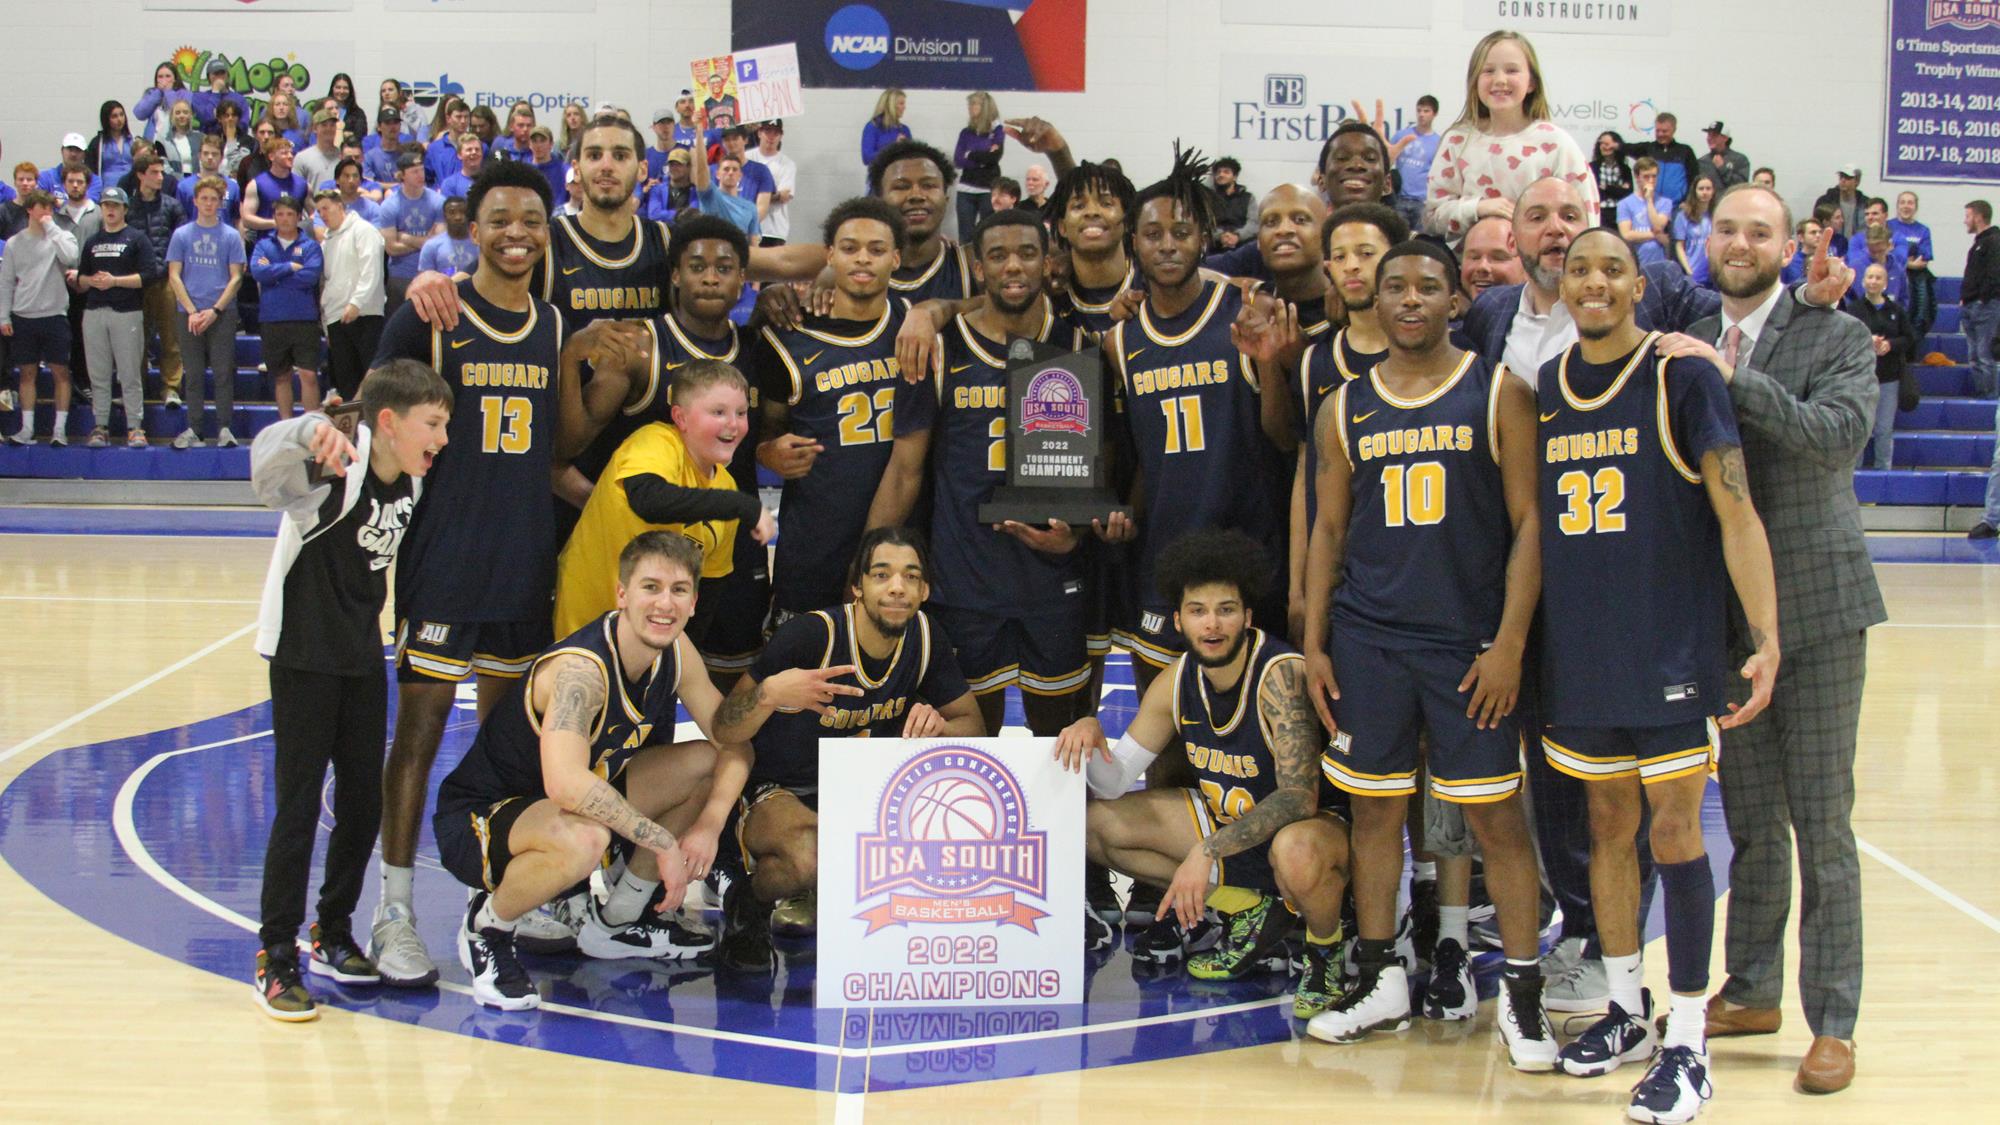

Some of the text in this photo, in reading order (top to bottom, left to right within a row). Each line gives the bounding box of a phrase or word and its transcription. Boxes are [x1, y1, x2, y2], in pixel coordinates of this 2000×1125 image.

[1499, 1, 1638, 21] CONSTRUCTION
[1934, 2, 1959, 19] USA
[831, 36, 979, 55] NCAA Division III
[1896, 38, 1904, 51] 6
[1906, 38, 1940, 53] Time
[1915, 62, 1963, 79] Trophy
[476, 92, 589, 112] Fiber Optics
[1268, 78, 1303, 106] FB
[1901, 92, 1965, 112] 2013-14,
[1232, 102, 1417, 141] FirstBnk
[1898, 118, 1962, 138] 2015-16,
[1899, 144, 1963, 165] 2017-18,
[1132, 360, 1229, 396] COUGARS
[837, 387, 895, 446] 22
[1027, 403, 1084, 417] USA SOUTH
[481, 396, 533, 454] 13
[1160, 395, 1205, 454] 11
[1042, 441, 1069, 450] 2022
[1358, 425, 1473, 461] COUGARS
[1546, 428, 1639, 463] COUGARS
[1026, 454, 1084, 465] TOURNAMENT
[1020, 464, 1089, 477] CHAMPIONS
[1381, 461, 1446, 527] 10
[1557, 467, 1626, 535] 32
[419, 623, 449, 643] AU
[1141, 612, 1163, 633] AU
[888, 756, 1018, 837] ATHLETIC CONFERENCE
[869, 845, 1035, 882] USA SOUTH
[895, 904, 1009, 919] BASKETBALL
[932, 899, 971, 907] MEN'S
[907, 935, 998, 965] 2022
[843, 969, 1060, 1001] CHAMPIONS
